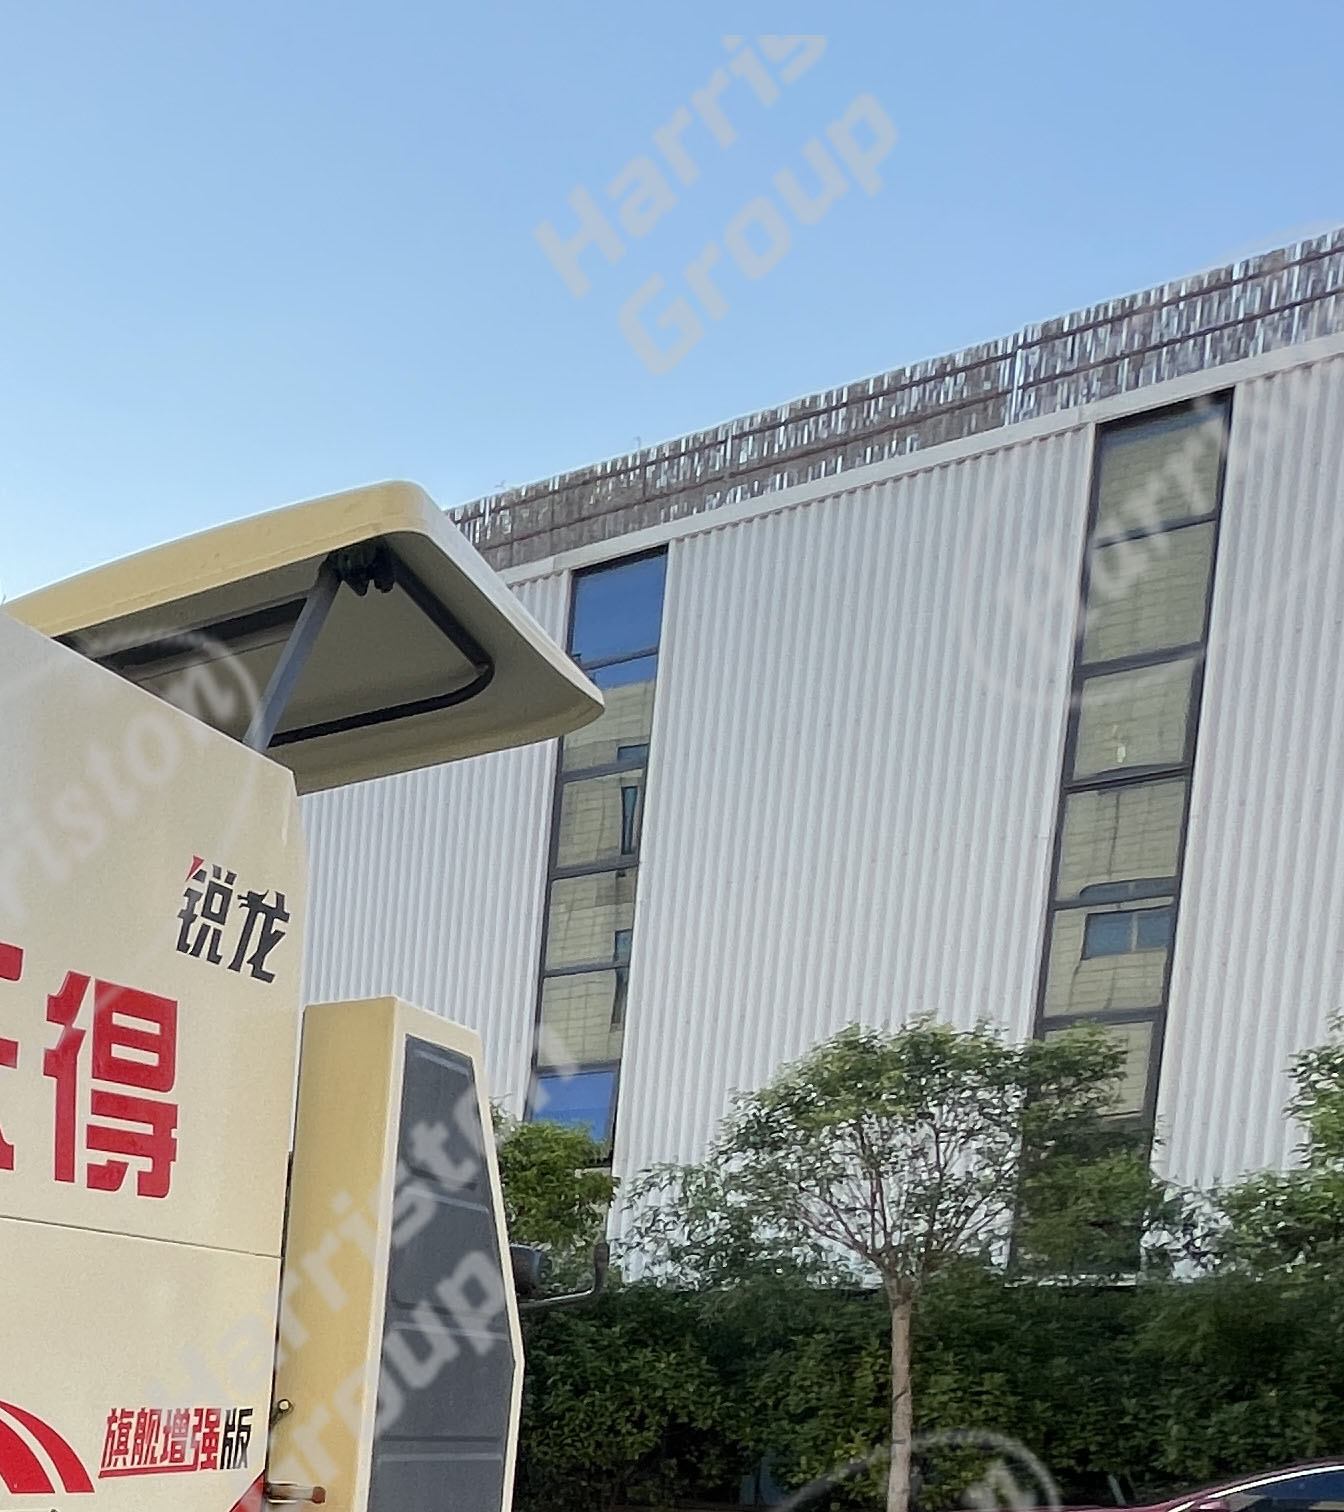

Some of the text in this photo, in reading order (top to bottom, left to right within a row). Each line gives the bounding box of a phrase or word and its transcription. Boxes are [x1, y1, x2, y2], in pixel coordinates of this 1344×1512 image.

[176, 855, 291, 984] 锐龙
[99, 1407, 254, 1476] 旗舰增强版
